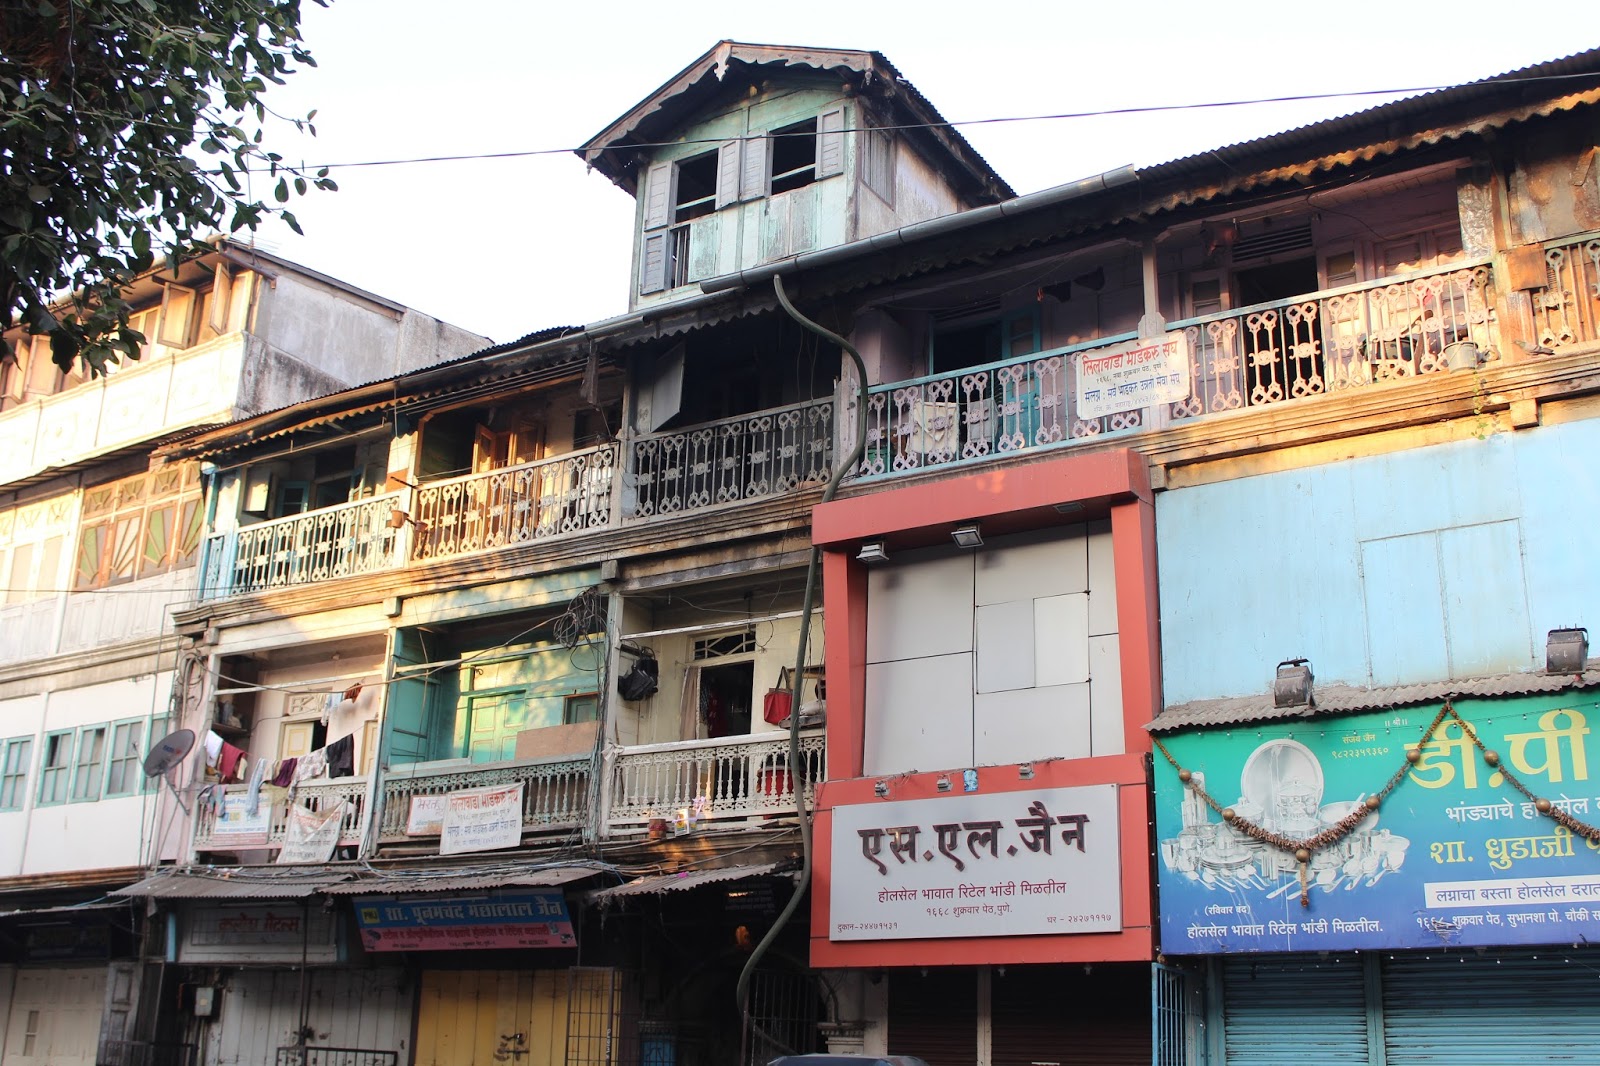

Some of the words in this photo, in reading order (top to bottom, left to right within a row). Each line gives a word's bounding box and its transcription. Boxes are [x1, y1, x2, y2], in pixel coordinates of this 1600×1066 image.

[1342, 734, 1361, 744] संजय
[1363, 732, 1376, 742] जैन
[1446, 797, 1514, 822] भांड्याचे
[1430, 841, 1474, 865] शा.
[1485, 825, 1575, 870] धुडाजी
[878, 885, 917, 903] होलसेल
[921, 887, 955, 901] भावात
[958, 882, 987, 899] रिटेल
[990, 881, 1016, 897] भांडी
[1020, 880, 1066, 896] मिळतील
[1436, 888, 1475, 902] लग्नाचा
[1480, 887, 1512, 900] बस्ता
[1517, 881, 1566, 900] होलसेल
[926, 907, 949, 918] १६६८
[953, 905, 979, 918] शुक्रवार
[1565, 907, 1589, 922] चौकी
[1187, 922, 1227, 939] होलसेल
[1231, 923, 1264, 936] भावात
[1268, 920, 1297, 935] रिटेल
[1300, 919, 1328, 935] भांडी
[1332, 917, 1383, 934] मिळतील.
